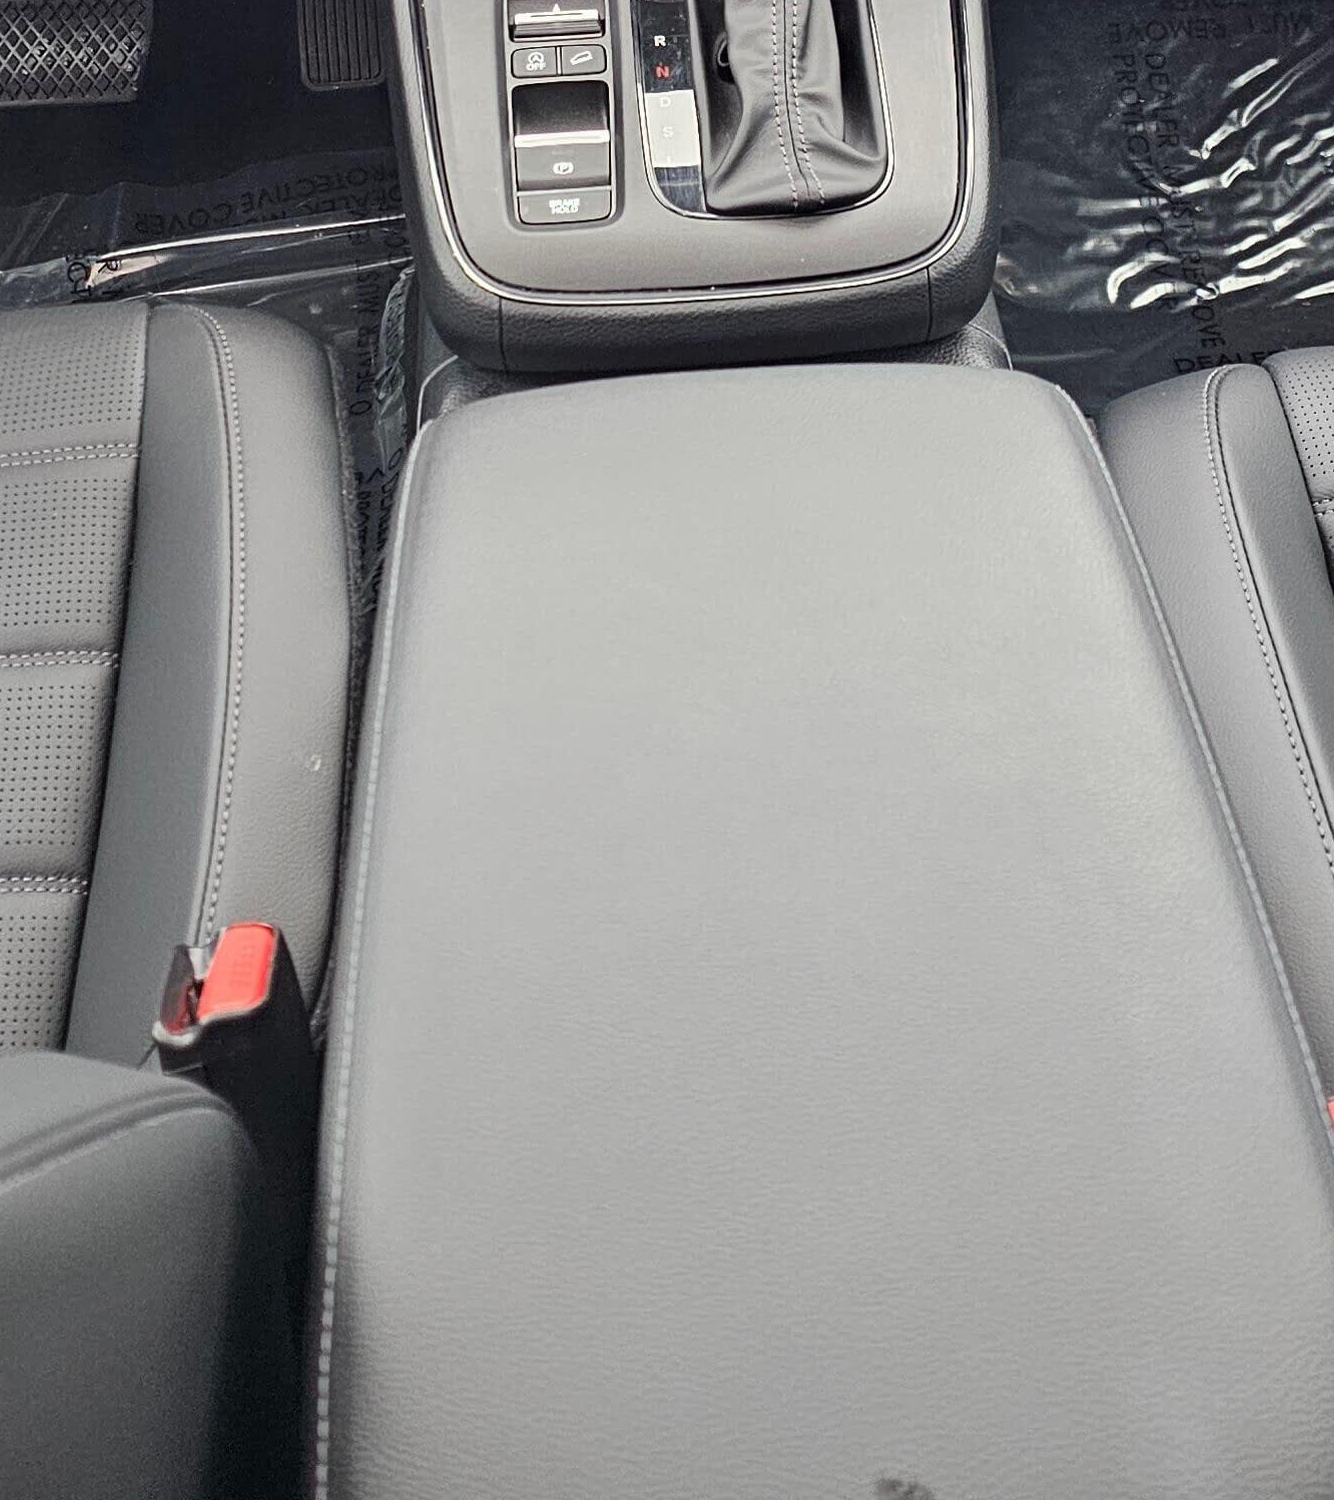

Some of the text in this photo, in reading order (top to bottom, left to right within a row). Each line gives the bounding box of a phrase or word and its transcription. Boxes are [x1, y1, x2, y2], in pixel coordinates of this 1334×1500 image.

[1105, 17, 1227, 45] REMOVE
[654, 35, 666, 47] R
[526, 61, 547, 71] OFF
[656, 65, 670, 78] N
[660, 96, 671, 107] D
[662, 127, 674, 138] S
[549, 198, 581, 207] BRAKE
[551, 206, 579, 215] HOLD
[133, 200, 232, 236] COVER
